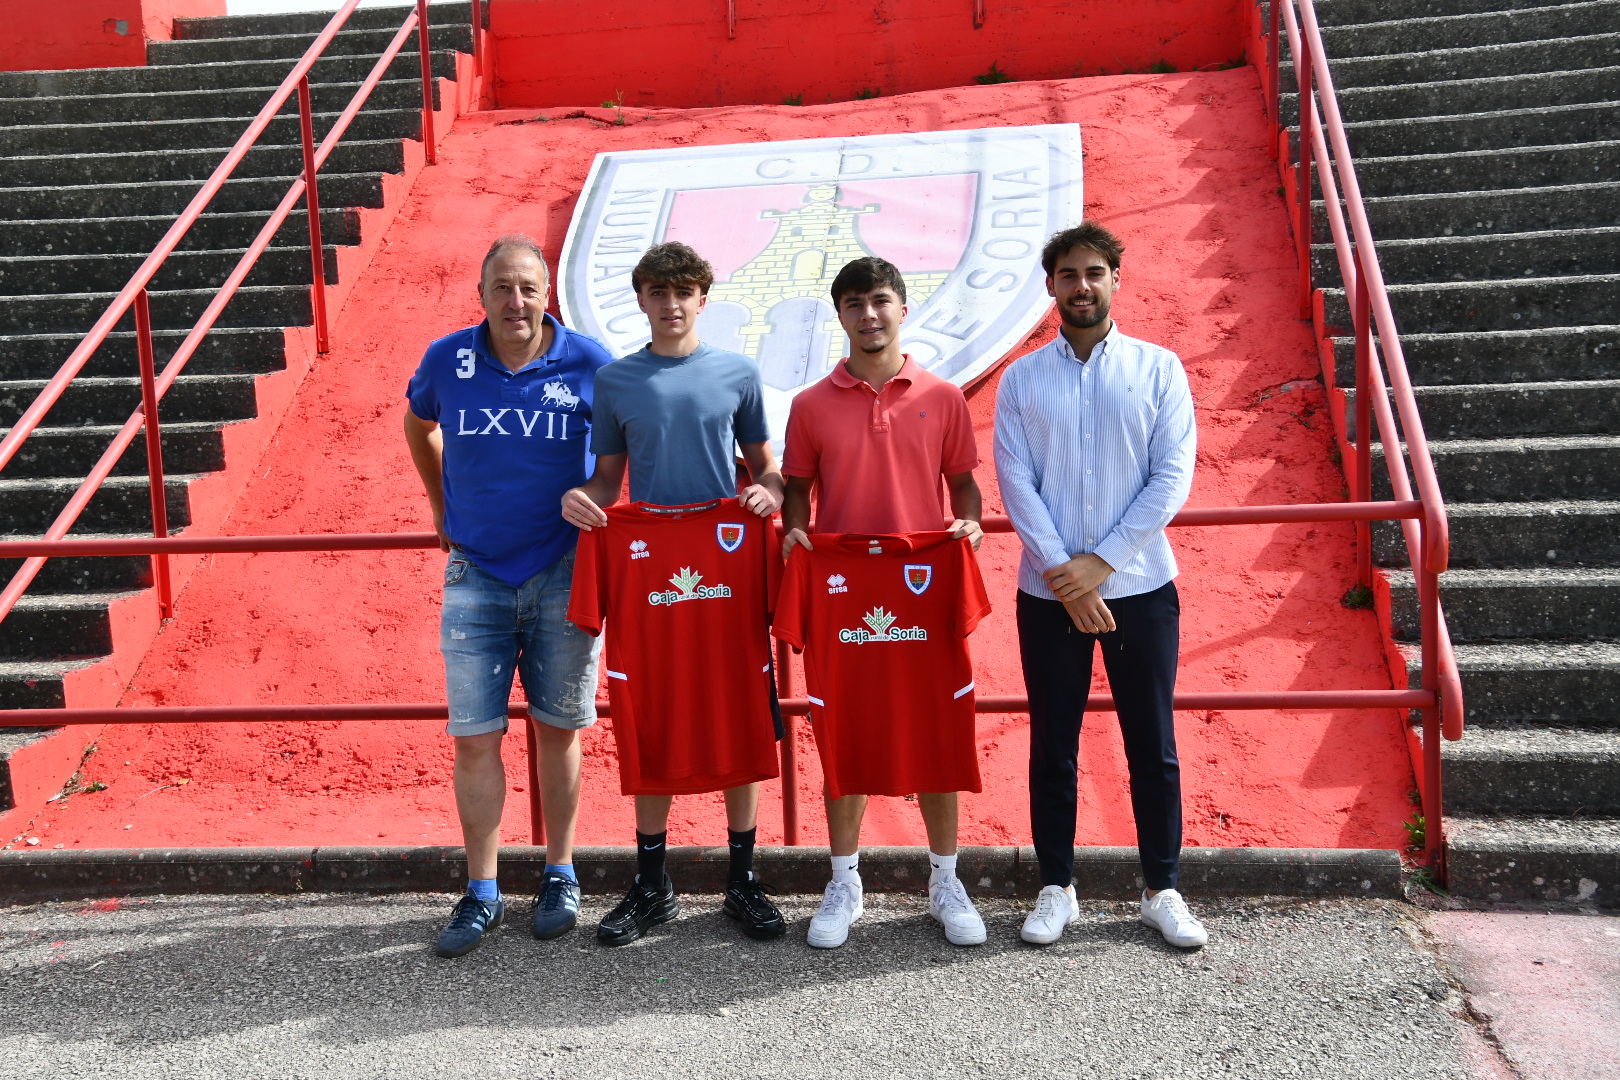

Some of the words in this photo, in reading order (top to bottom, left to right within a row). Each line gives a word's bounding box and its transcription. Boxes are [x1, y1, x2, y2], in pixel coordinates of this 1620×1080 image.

[966, 165, 1043, 293] SORIA
[594, 188, 659, 351] NUMANCI
[455, 348, 476, 379] 3
[457, 408, 568, 440] LXVII
[631, 551, 650, 560] errea
[649, 590, 678, 605] Caja
[698, 584, 730, 599] Soria
[828, 585, 848, 595] errea
[840, 628, 869, 644] Caja
[890, 627, 926, 640] Soria
